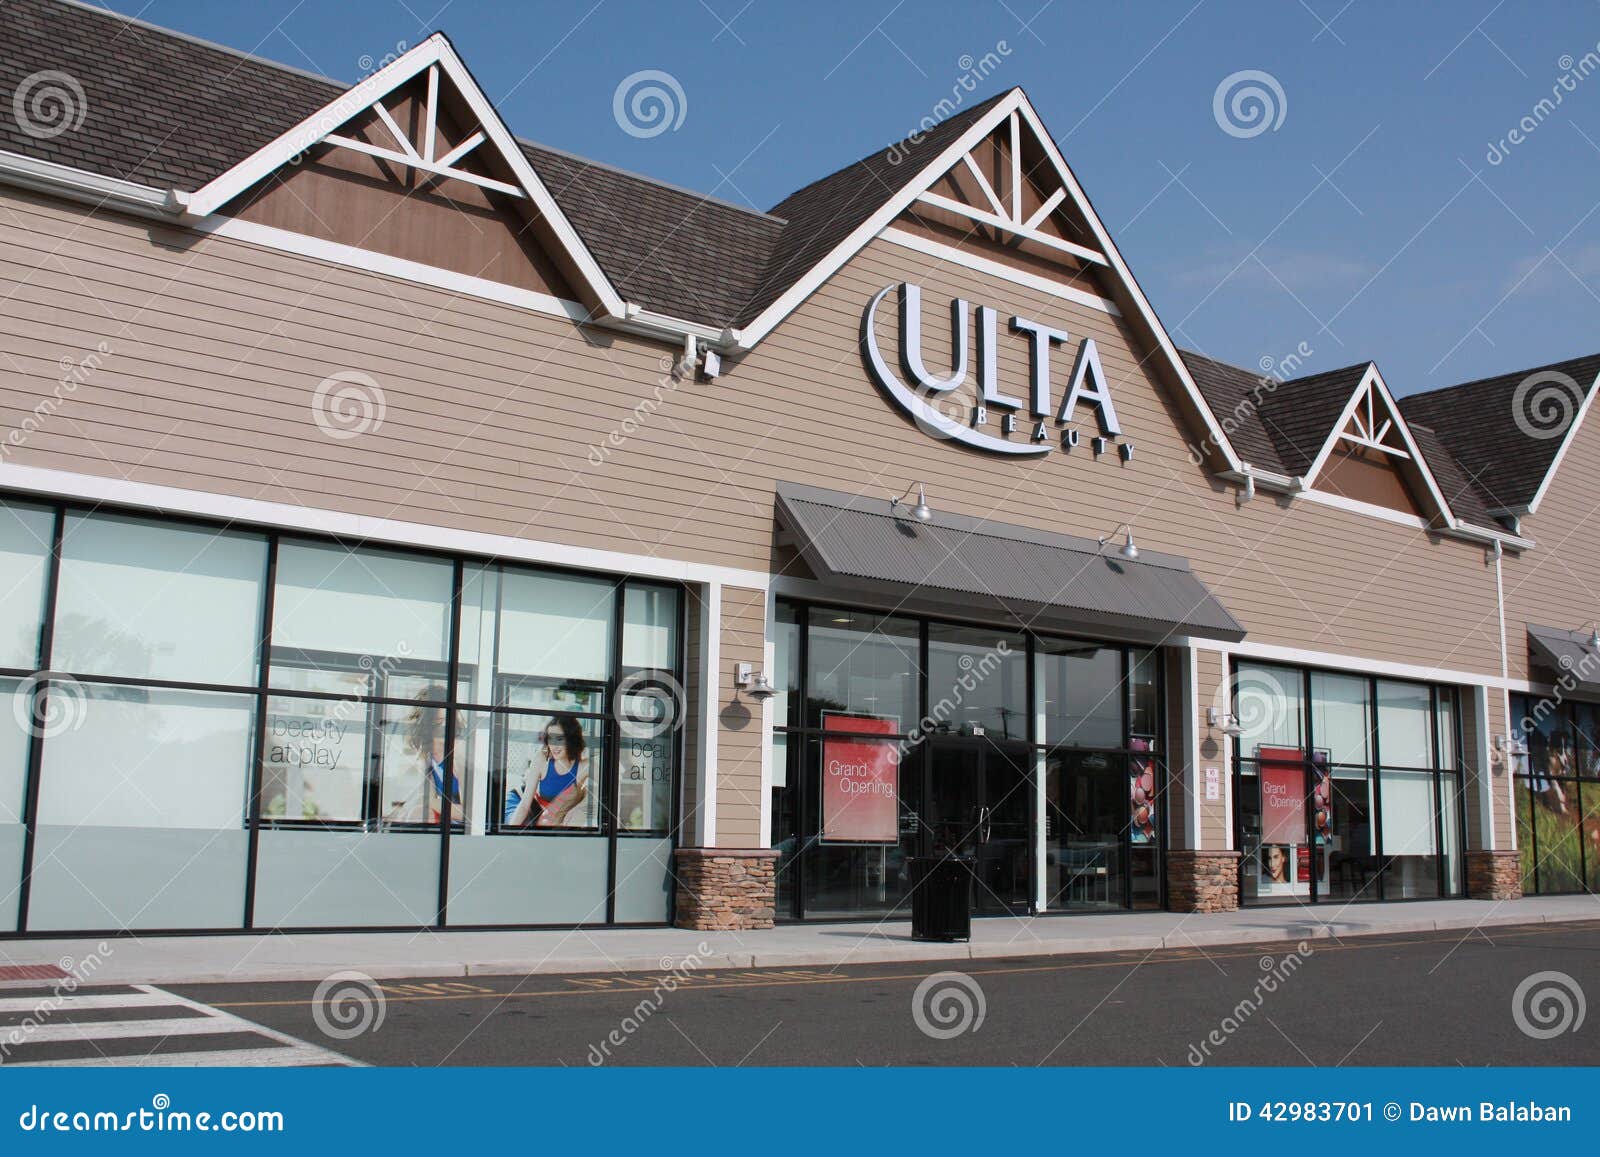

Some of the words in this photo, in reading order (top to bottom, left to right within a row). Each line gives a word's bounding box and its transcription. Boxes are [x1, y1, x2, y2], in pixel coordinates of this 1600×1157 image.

[898, 282, 1122, 437] ULTA
[974, 406, 1135, 462] BEAUTY
[272, 714, 347, 745] beauty
[270, 742, 292, 763] at
[298, 743, 342, 770] play
[829, 760, 867, 777] Grand
[630, 762, 647, 781] at
[1263, 781, 1286, 794] Grand
